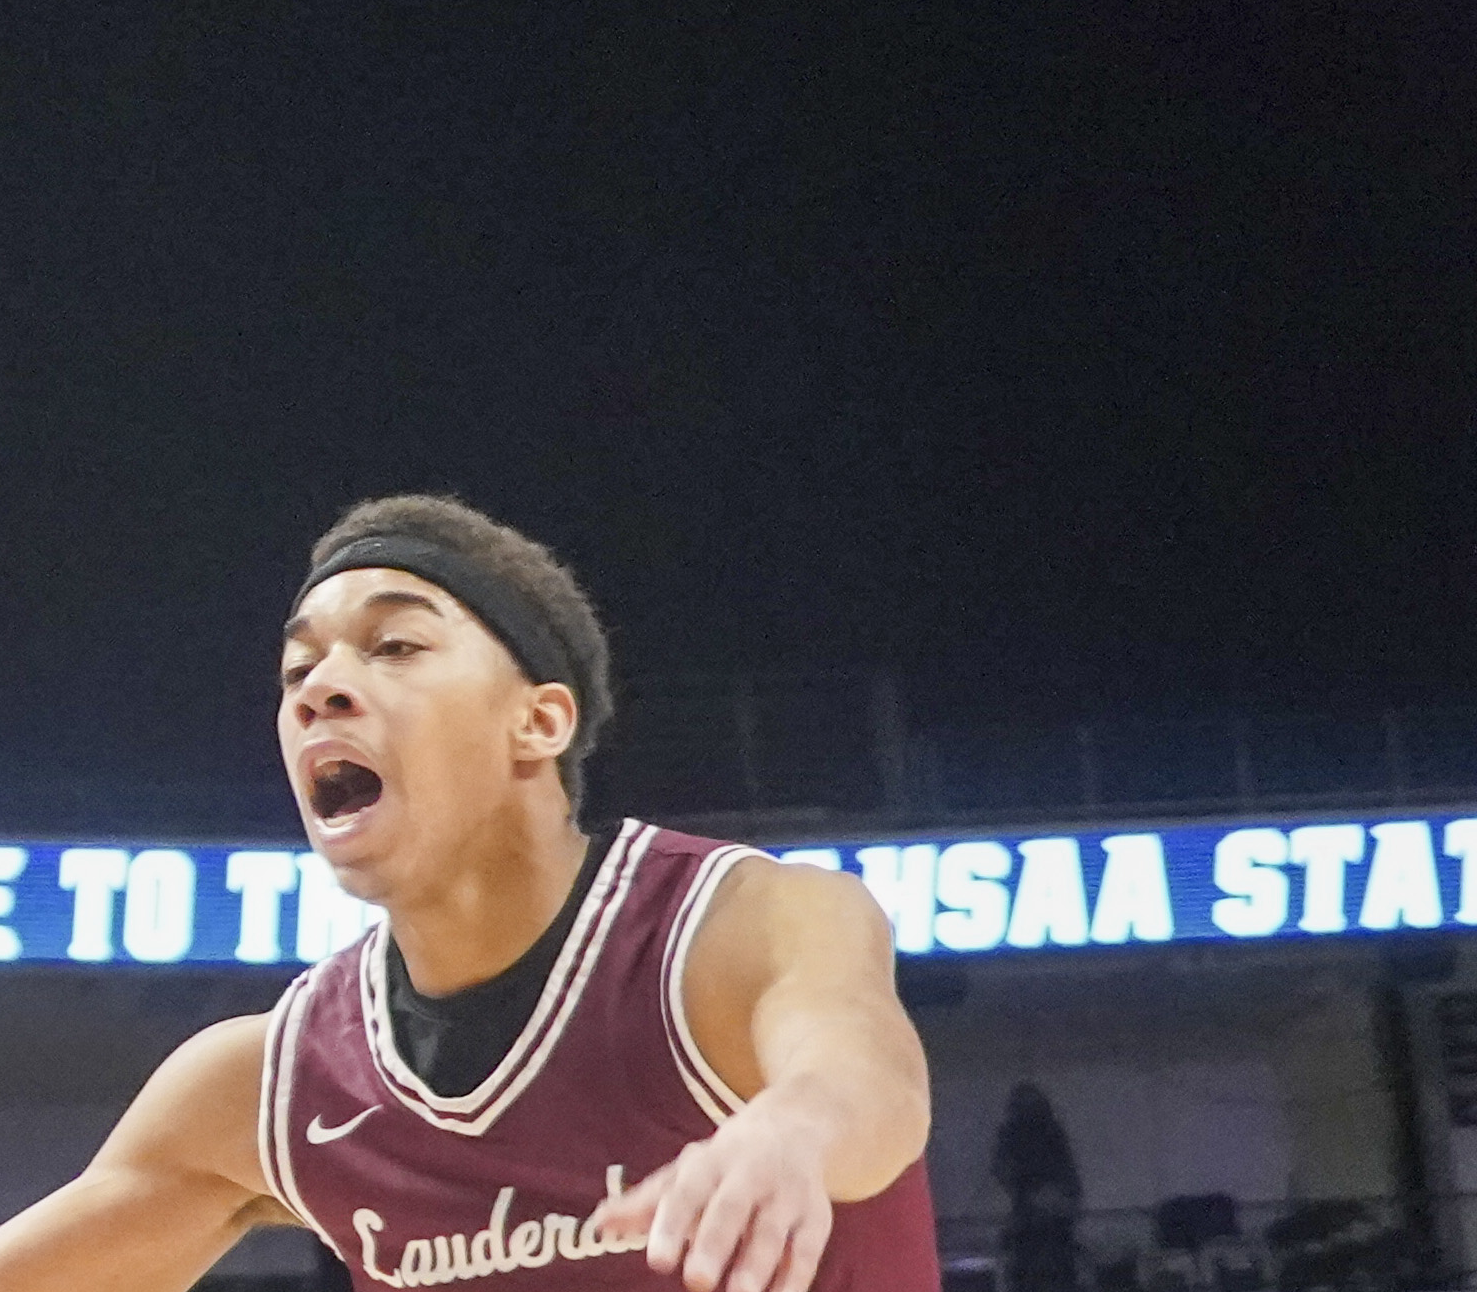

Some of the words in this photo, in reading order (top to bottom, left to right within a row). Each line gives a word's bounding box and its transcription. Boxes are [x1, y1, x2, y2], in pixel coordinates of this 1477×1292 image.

[60, 848, 196, 963] TO
[226, 851, 389, 964] TH
[780, 833, 1174, 954] HSAA
